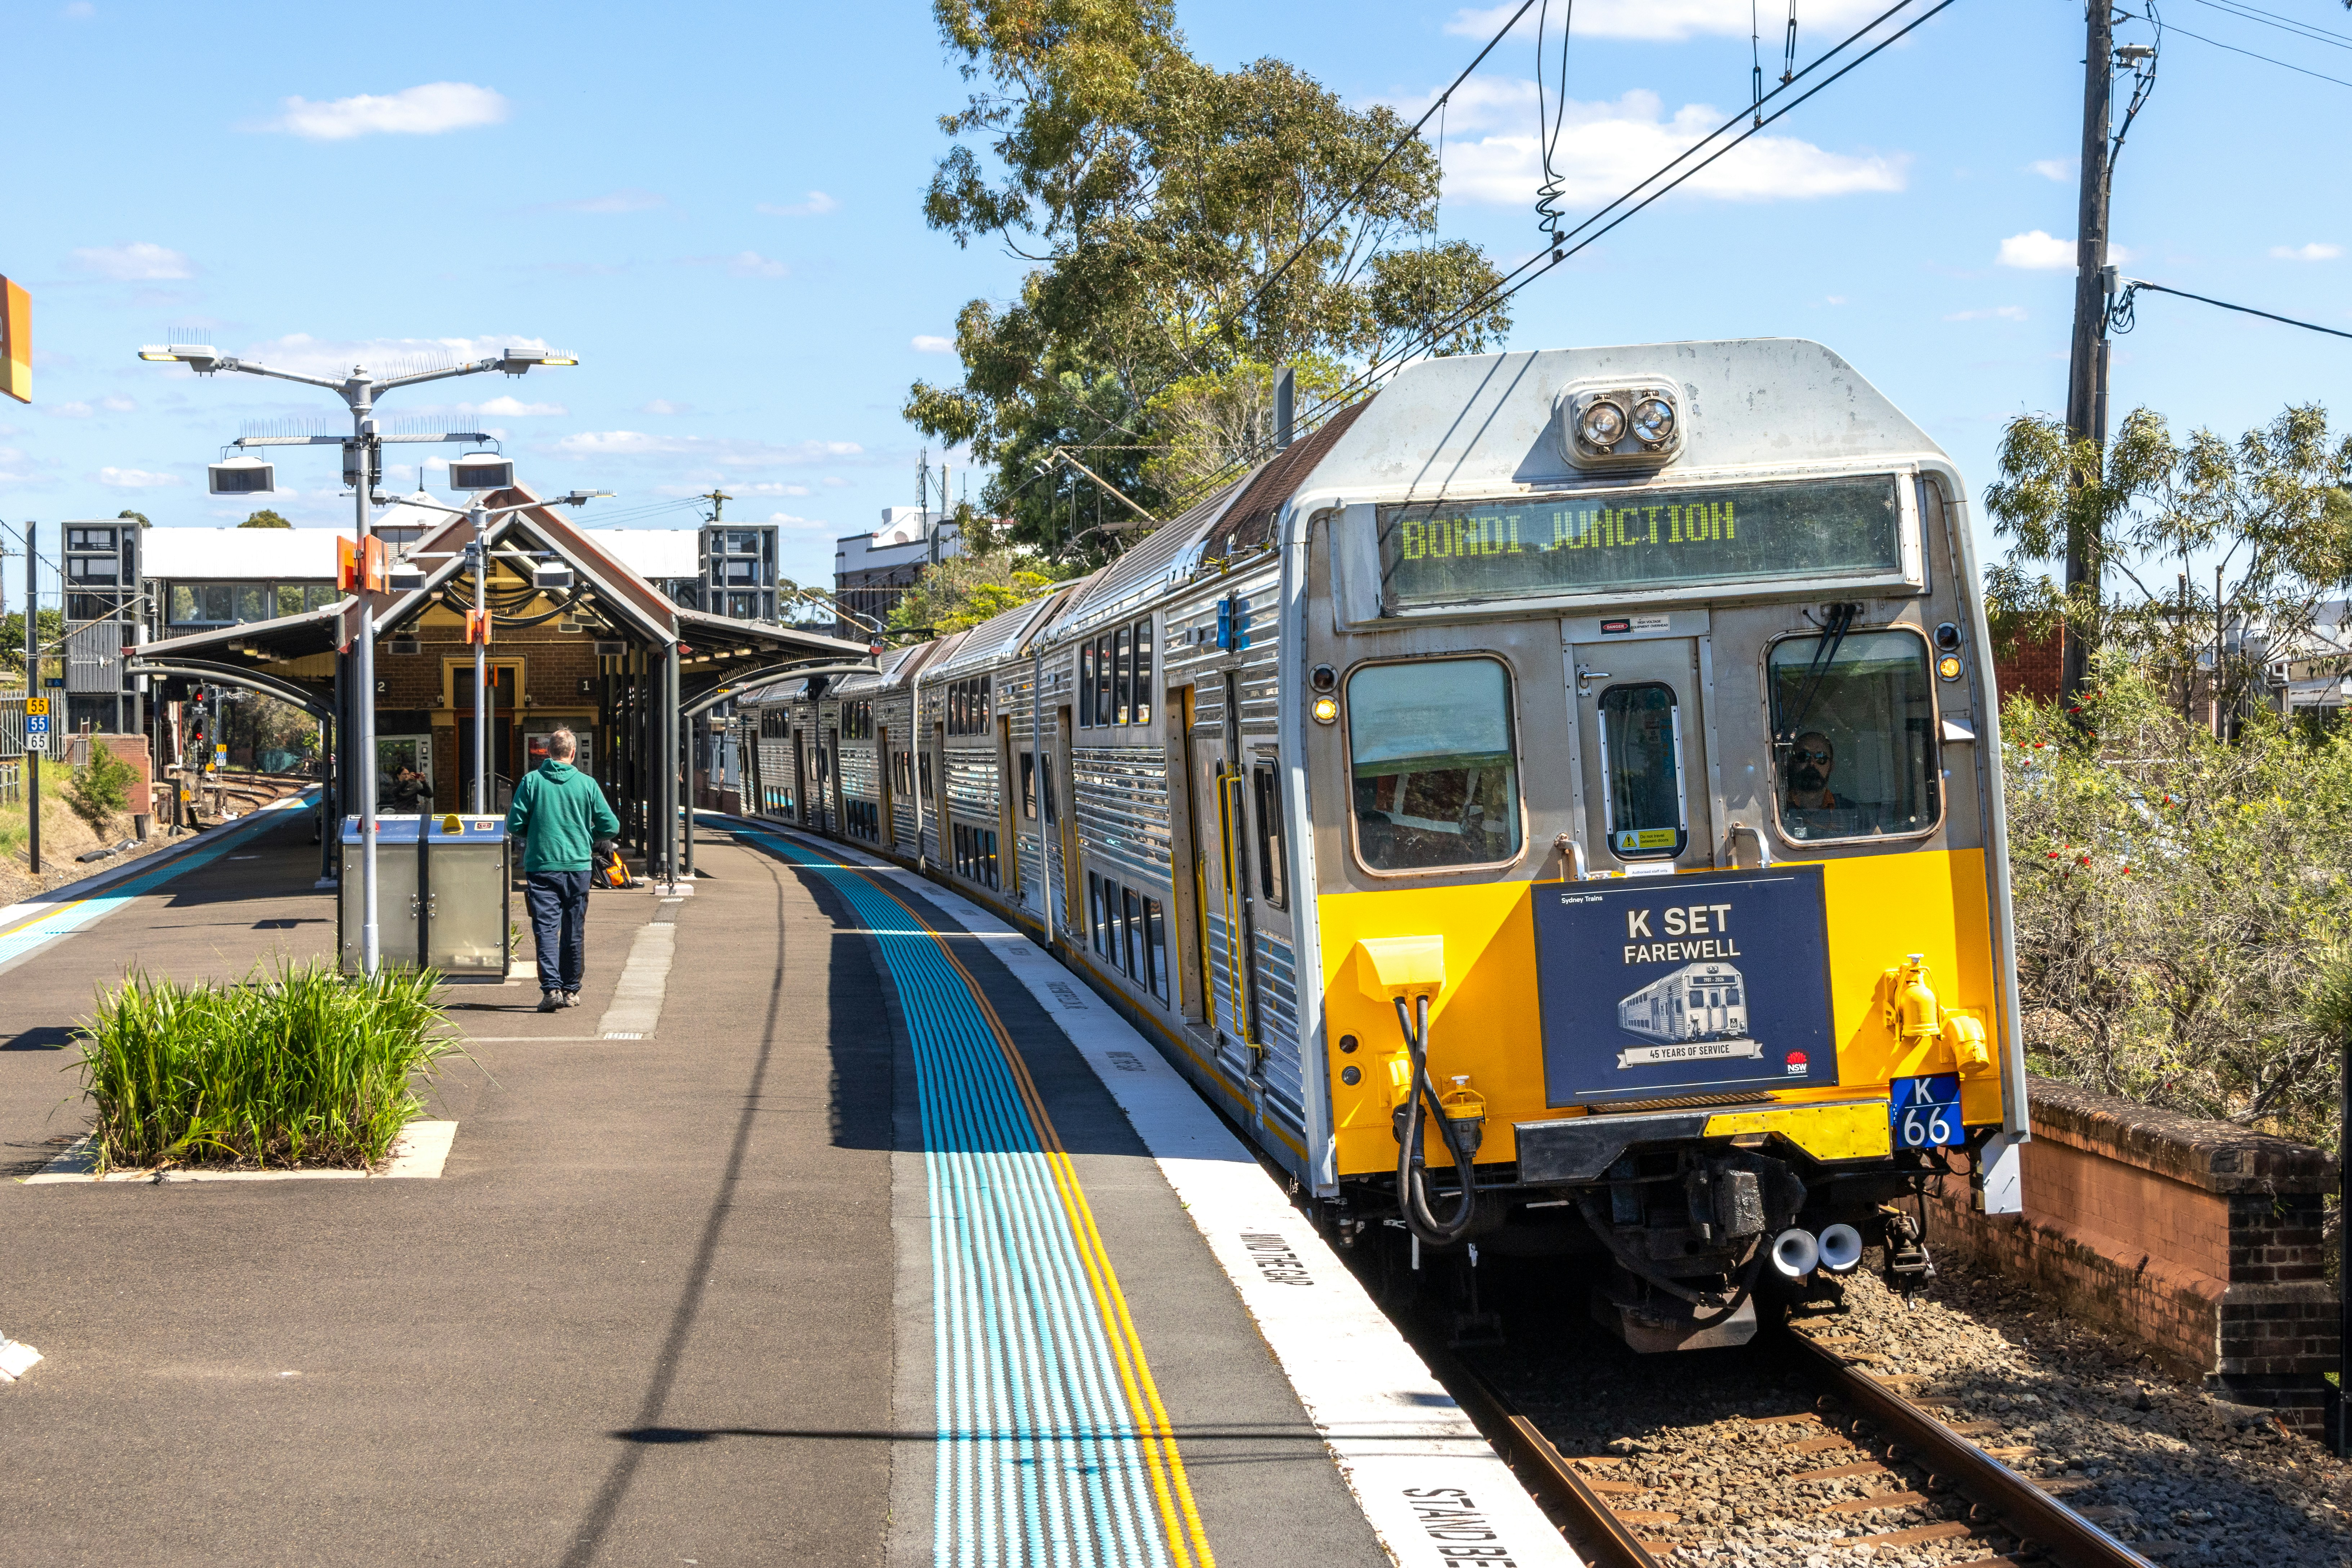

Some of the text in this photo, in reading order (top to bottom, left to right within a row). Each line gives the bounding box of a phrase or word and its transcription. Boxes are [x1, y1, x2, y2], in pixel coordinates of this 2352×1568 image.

[1401, 501, 1735, 560] BONDI JUNCTION
[378, 682, 385, 692] 2
[584, 680, 589, 690] 1
[31, 700, 44, 712] 55
[31, 718, 45, 731] 55
[31, 736, 45, 748] 65
[1628, 904, 1731, 938] K SET
[1624, 939, 1740, 964] FAREWELL
[1650, 1045, 1730, 1058] 45 YEARS OF SERVICE
[1915, 1078, 1933, 1104] K
[1904, 1107, 1950, 1145] 66
[1239, 1233, 1314, 1285] MIND THE GAP
[1402, 1488, 1497, 1540] STAND
